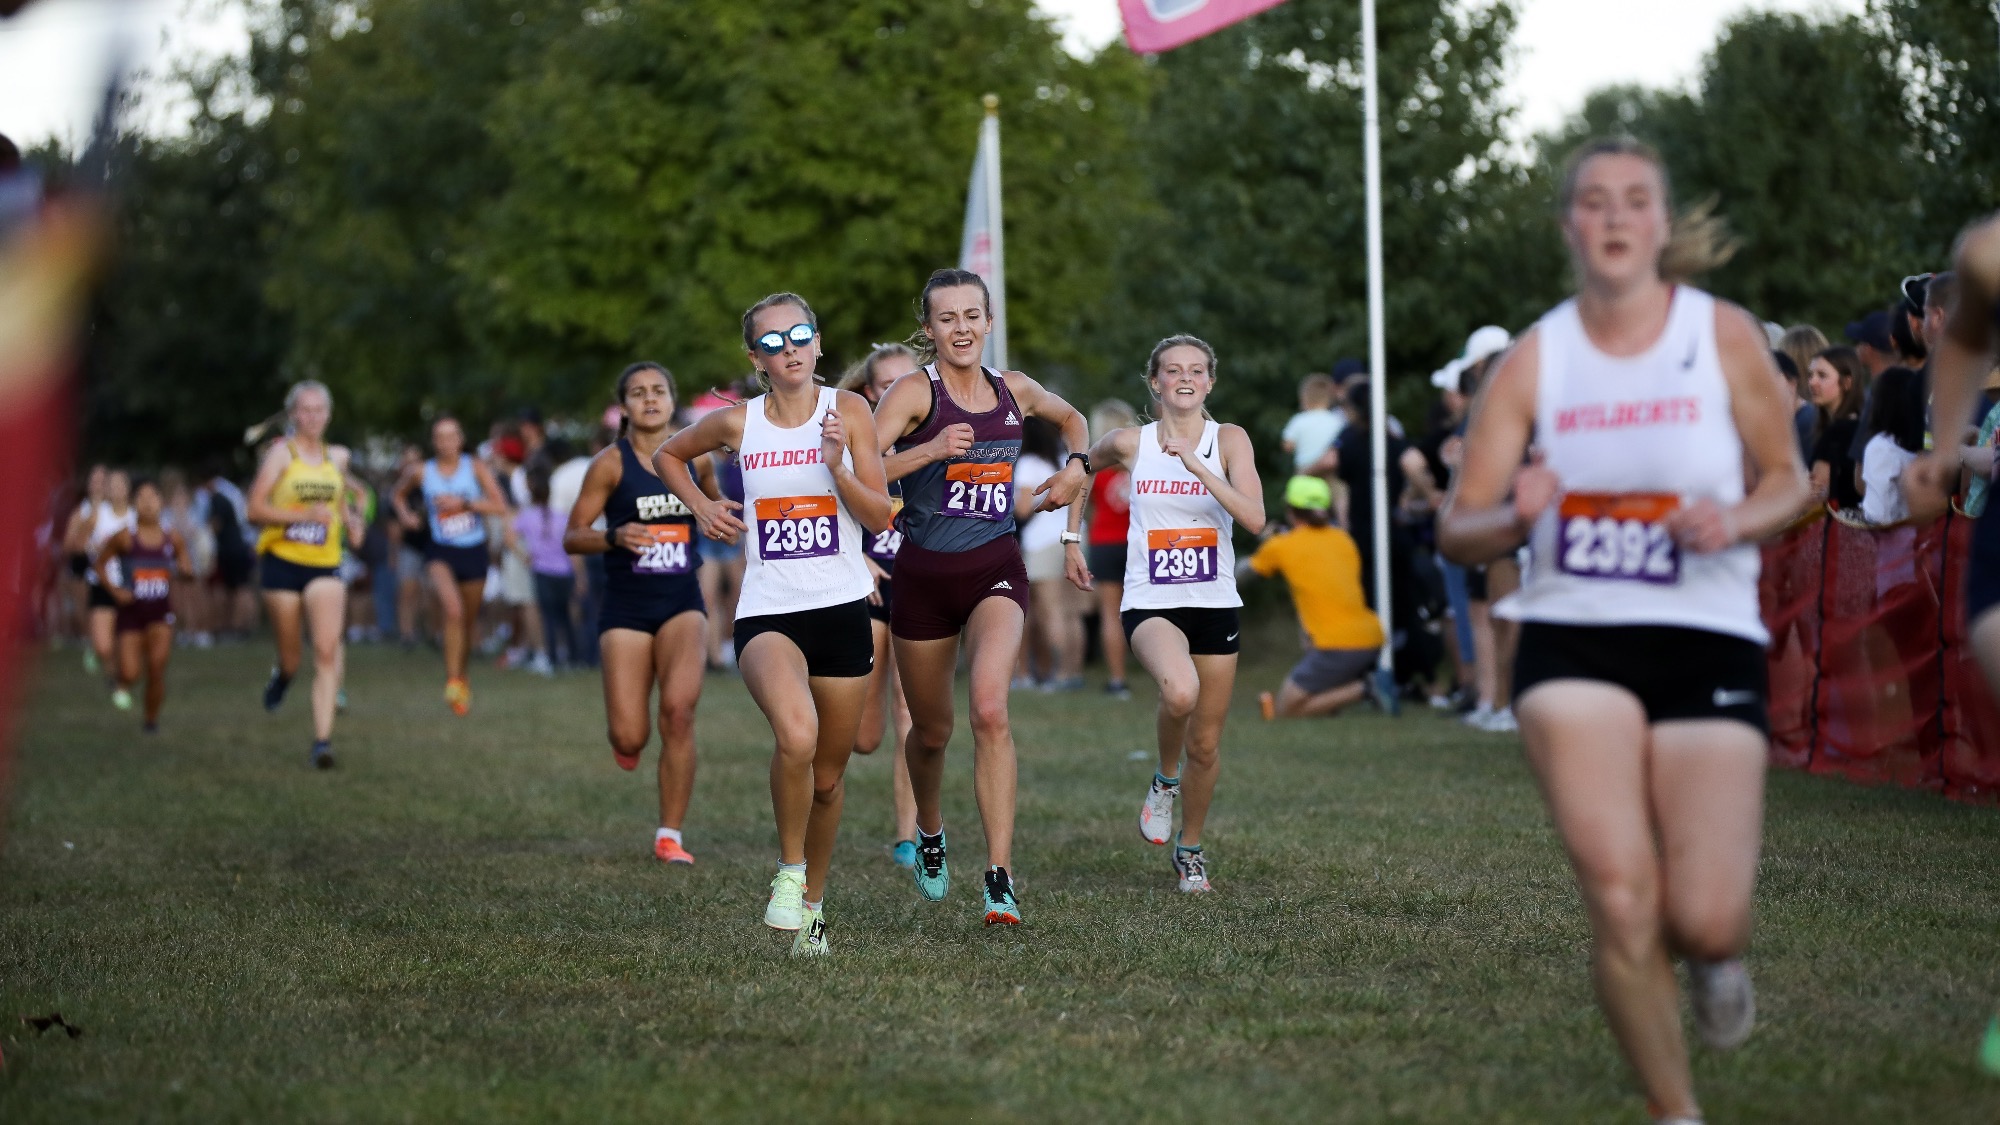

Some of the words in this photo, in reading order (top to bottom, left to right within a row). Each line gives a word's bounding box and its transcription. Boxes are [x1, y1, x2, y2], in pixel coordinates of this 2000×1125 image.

[743, 448, 825, 471] WILDCA
[948, 480, 1007, 513] 2176
[1136, 480, 1208, 496] WILDCAT
[639, 503, 693, 520] EAGLE
[765, 516, 832, 552] 2396
[872, 529, 903, 554] 24
[1563, 514, 1674, 576] 2392
[637, 541, 687, 568] 2204
[1154, 546, 1210, 578] 2391
